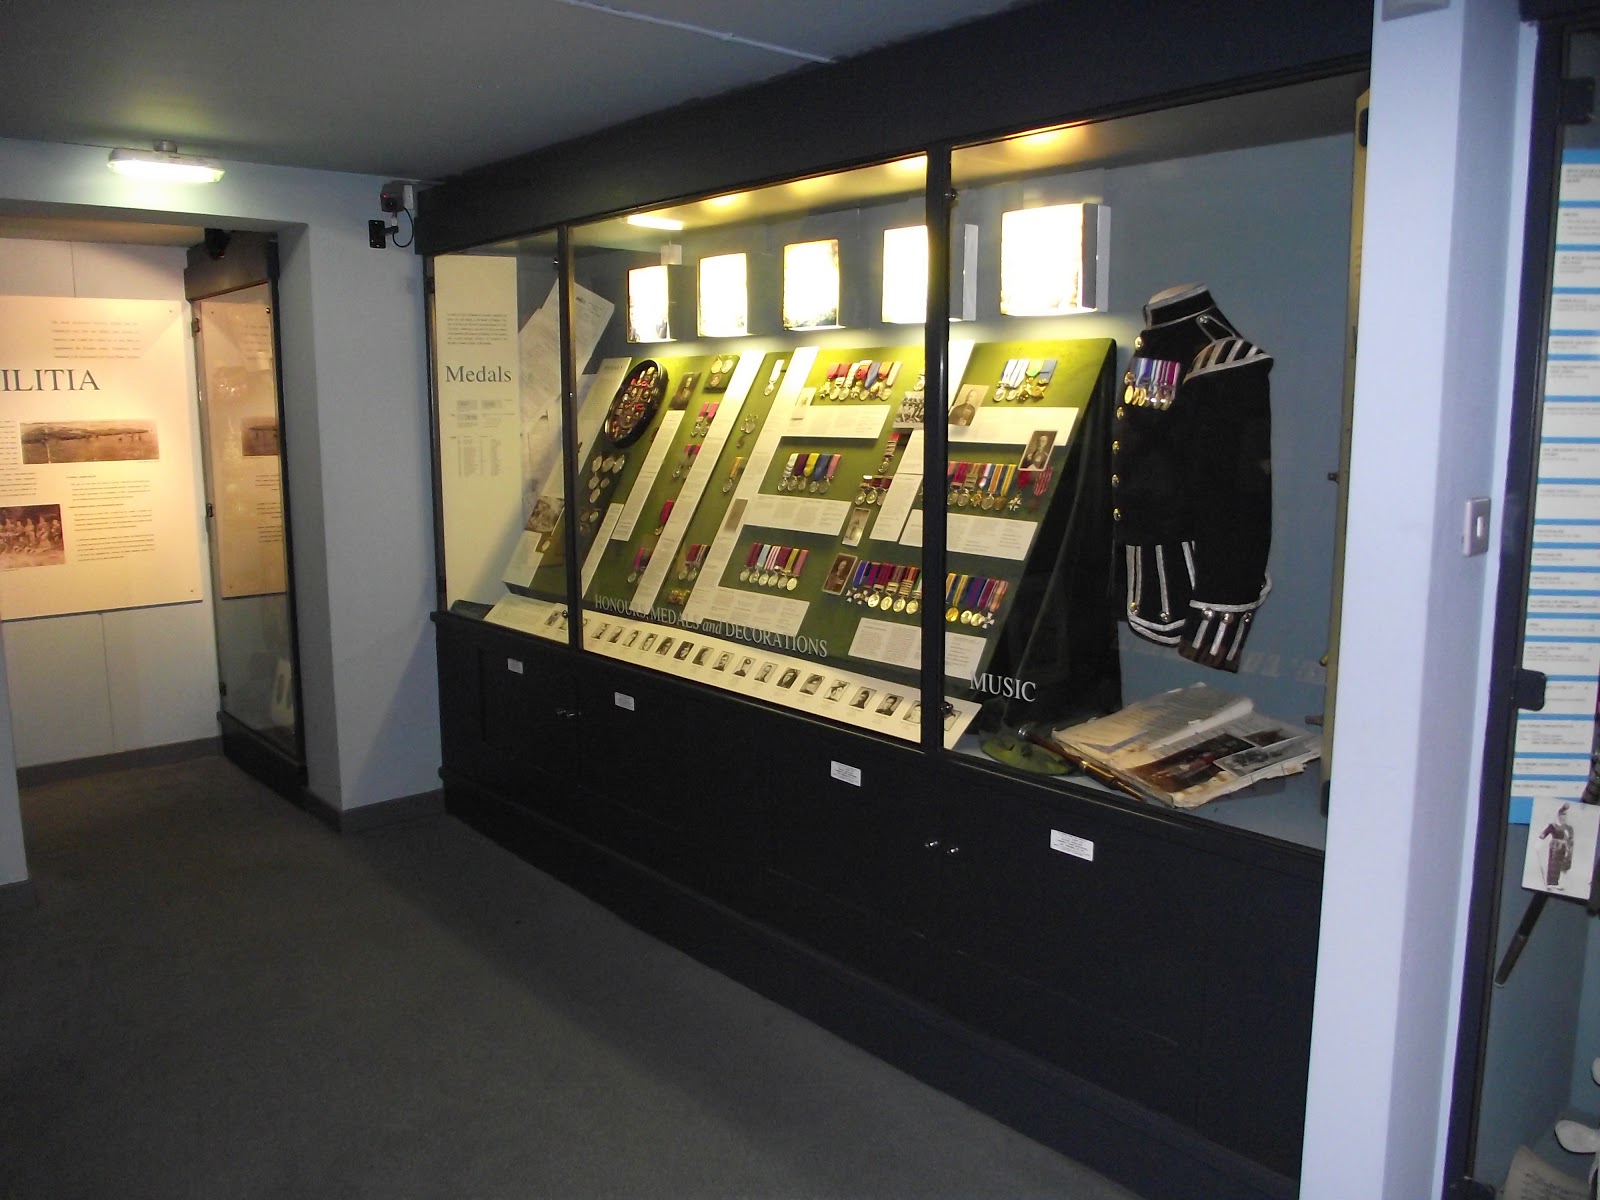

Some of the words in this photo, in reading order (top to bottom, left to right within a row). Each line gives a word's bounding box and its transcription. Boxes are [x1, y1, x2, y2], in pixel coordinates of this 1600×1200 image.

[1, 368, 101, 392] ILITIA
[445, 365, 512, 383] Medals
[650, 606, 700, 630] MEDALS
[702, 618, 723, 635] and
[725, 620, 828, 658] DECORATIONS
[969, 671, 1036, 702] MUSIC
